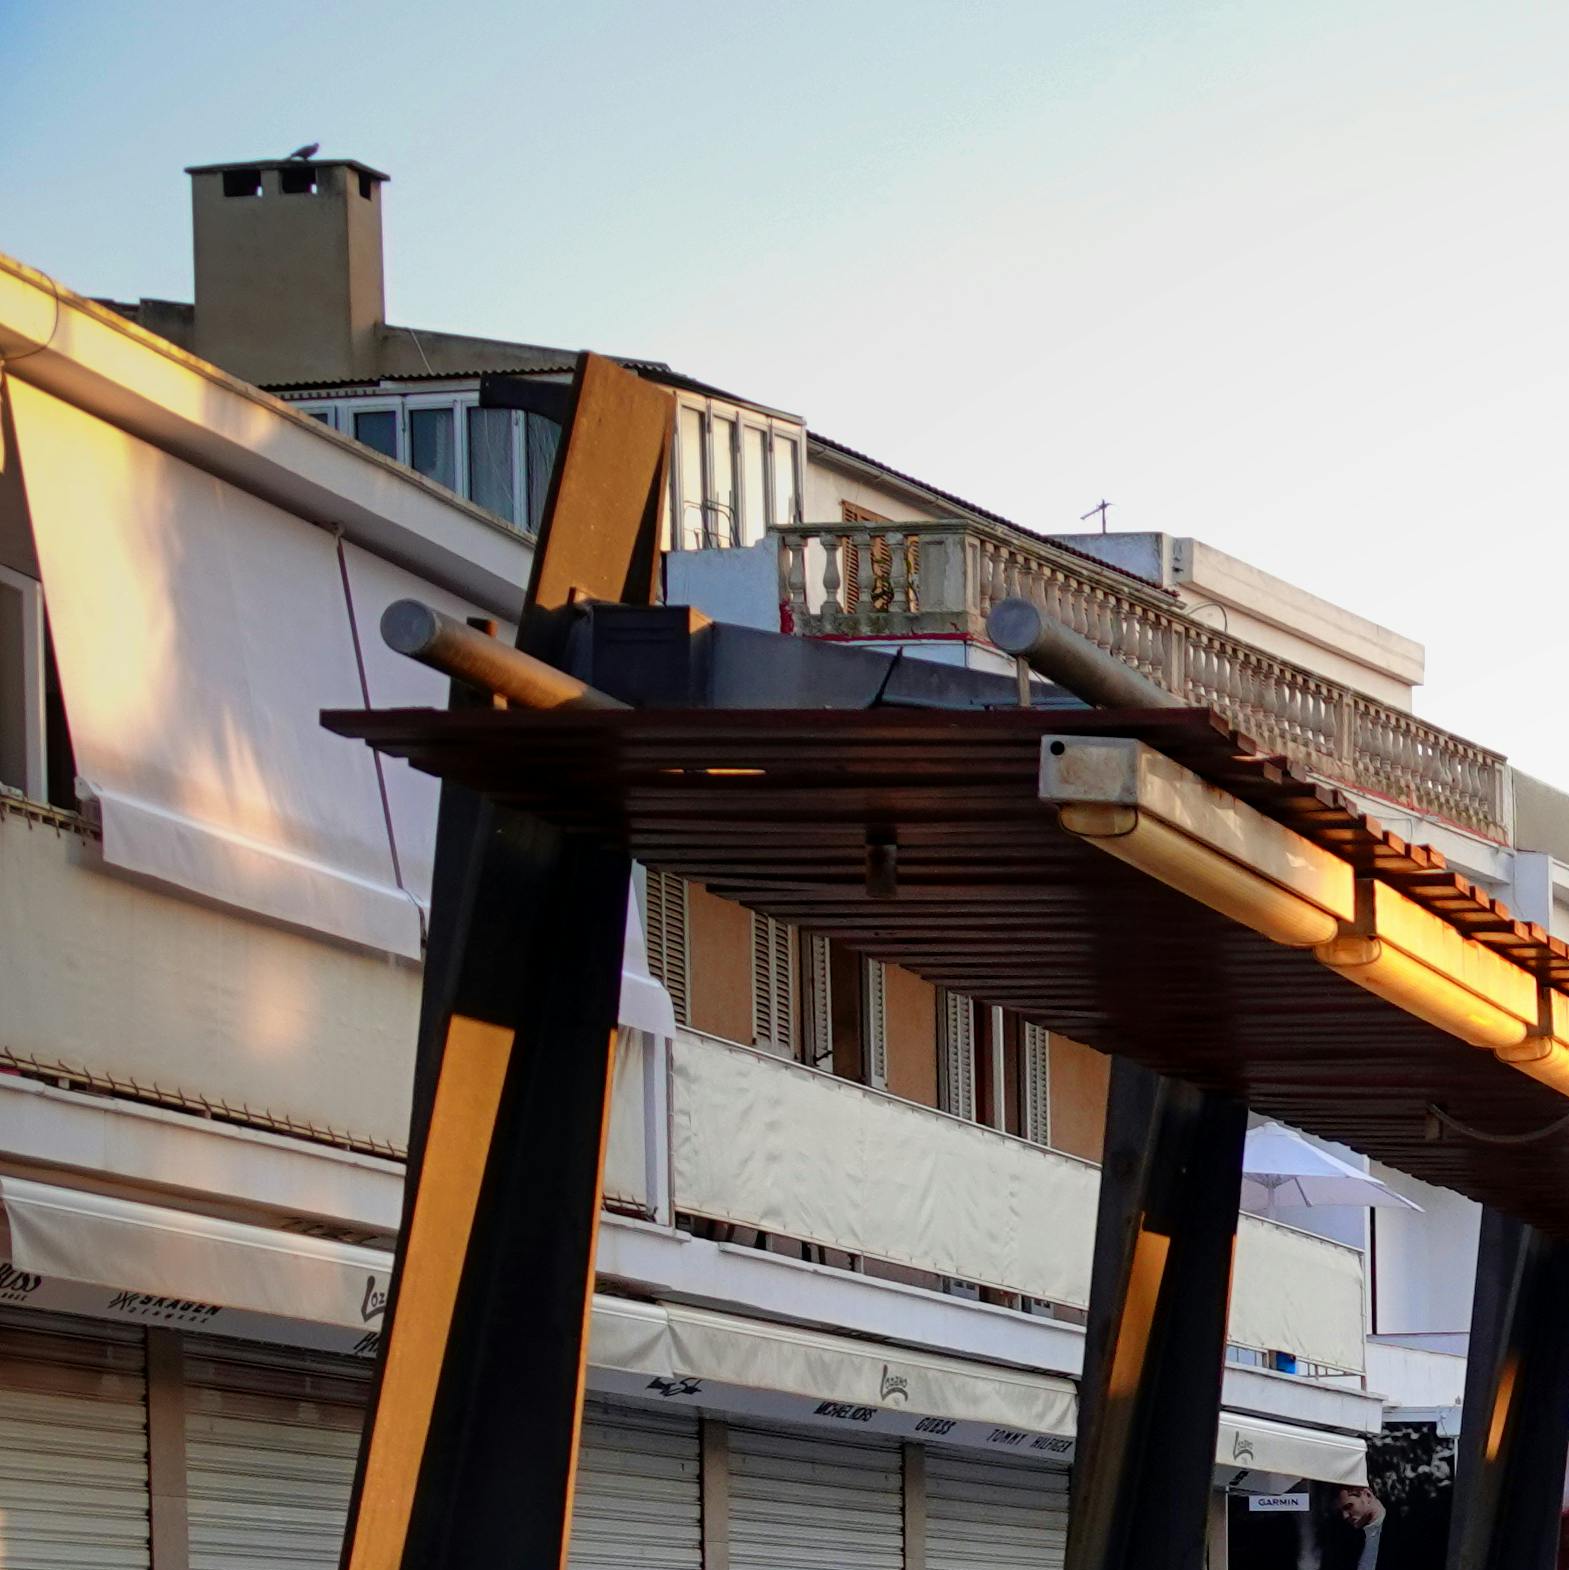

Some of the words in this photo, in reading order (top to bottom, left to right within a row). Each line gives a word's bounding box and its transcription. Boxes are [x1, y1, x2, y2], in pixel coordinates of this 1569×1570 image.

[361, 1275, 386, 1323] Loz
[986, 1428, 1028, 1446] TOMMY
[1257, 1498, 1299, 1506] GARMIN
